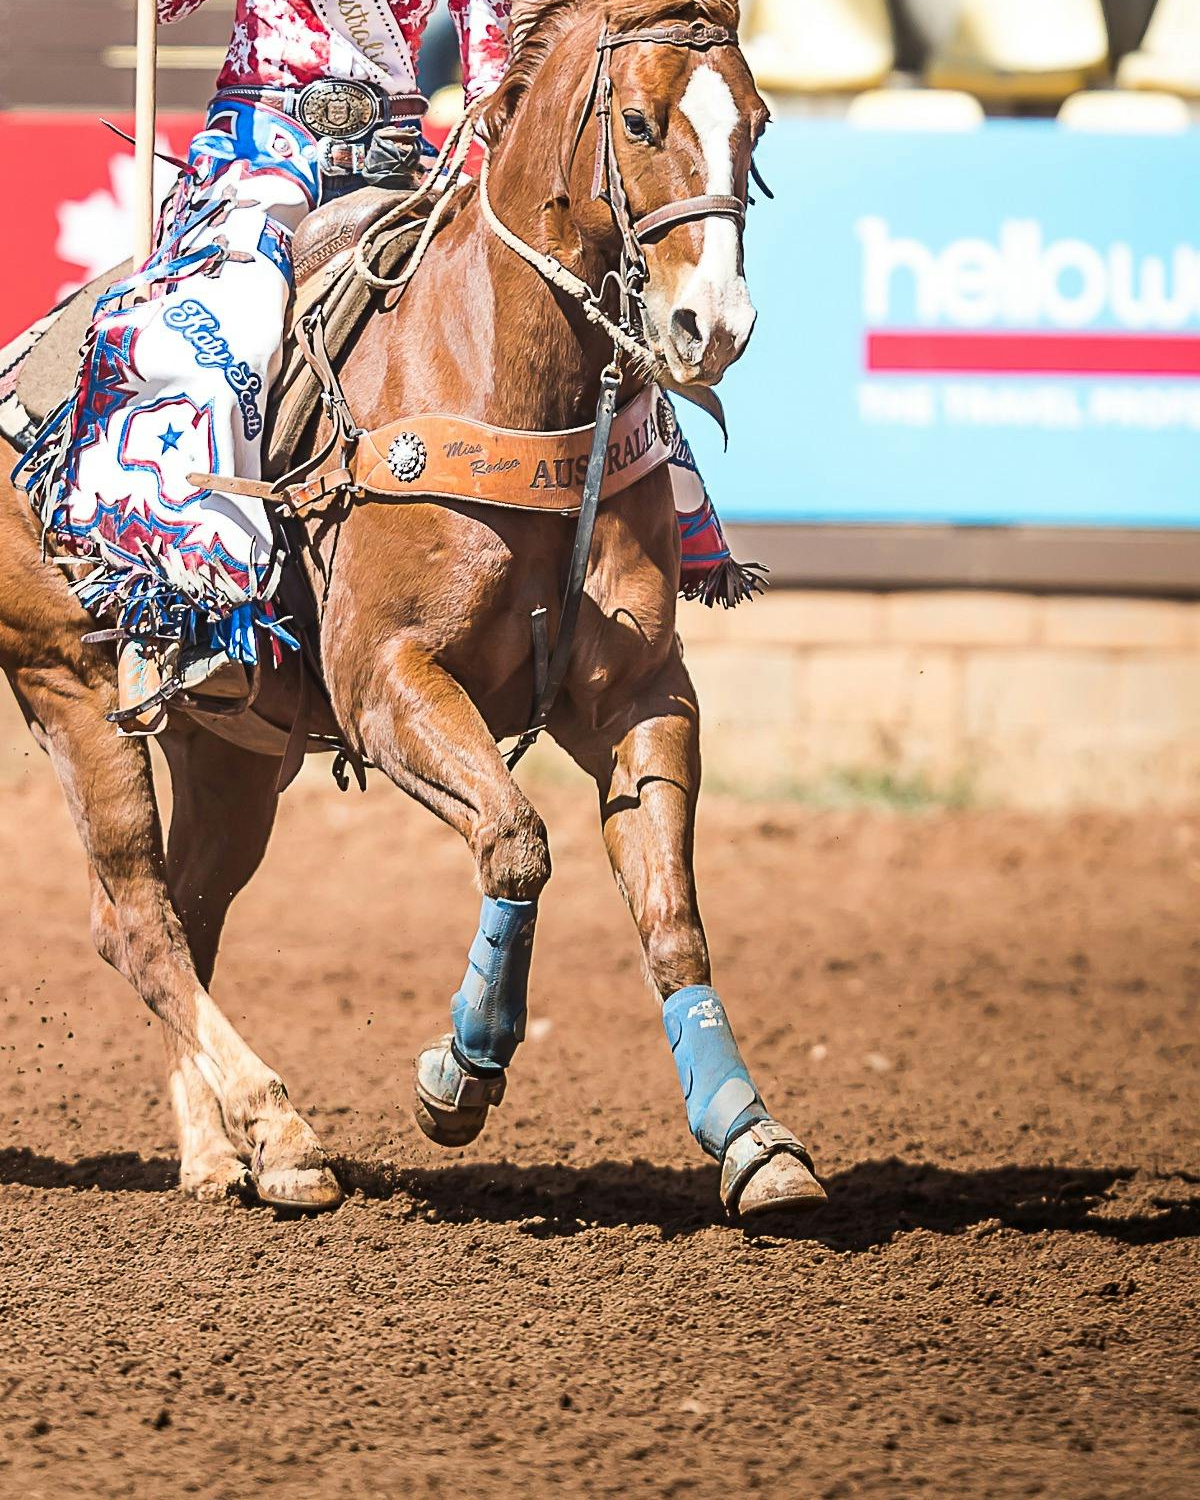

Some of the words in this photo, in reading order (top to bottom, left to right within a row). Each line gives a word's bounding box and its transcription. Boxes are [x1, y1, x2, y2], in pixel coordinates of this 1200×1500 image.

[163, 300, 233, 368] Katy
[225, 362, 261, 438] Scott
[442, 440, 483, 458] Miss
[470, 457, 520, 477] Rodeo
[530, 412, 658, 489] AUSRALIA
